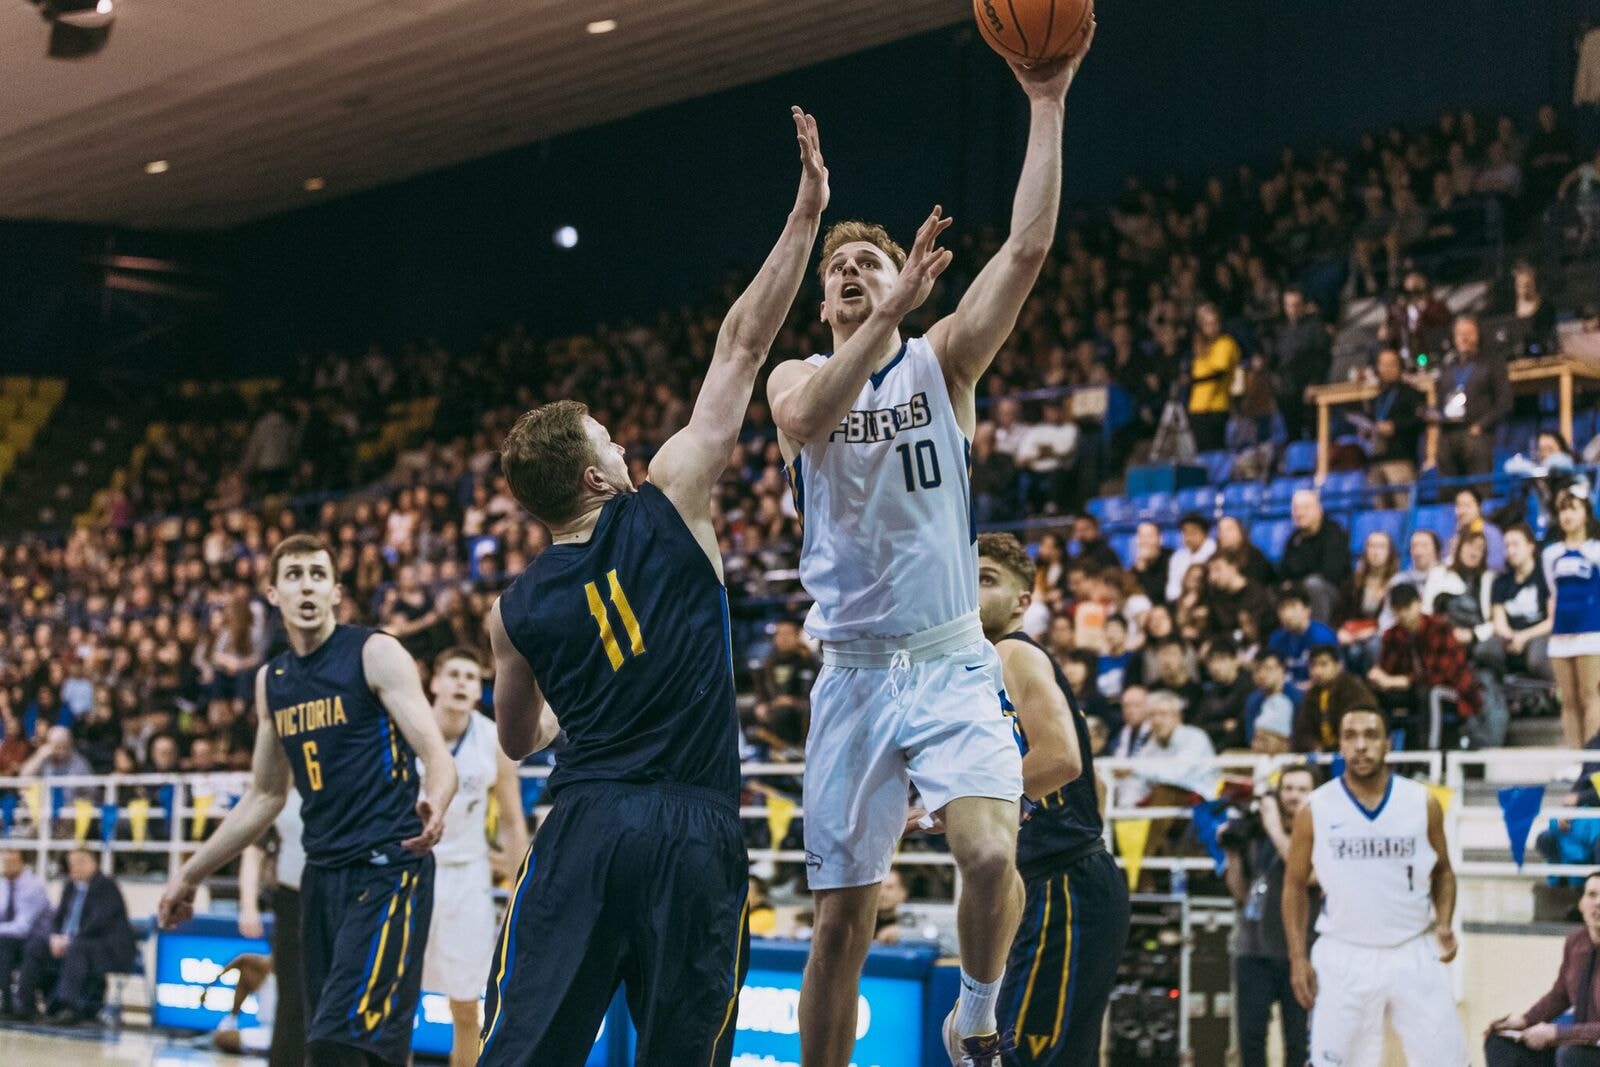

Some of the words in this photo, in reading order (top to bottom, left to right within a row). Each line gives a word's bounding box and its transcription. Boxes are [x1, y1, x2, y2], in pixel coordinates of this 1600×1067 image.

[895, 438, 942, 493] 10
[584, 568, 646, 672] 11
[274, 695, 349, 737] VICTORIA
[303, 740, 323, 791] 6
[1404, 864, 1415, 892] 1
